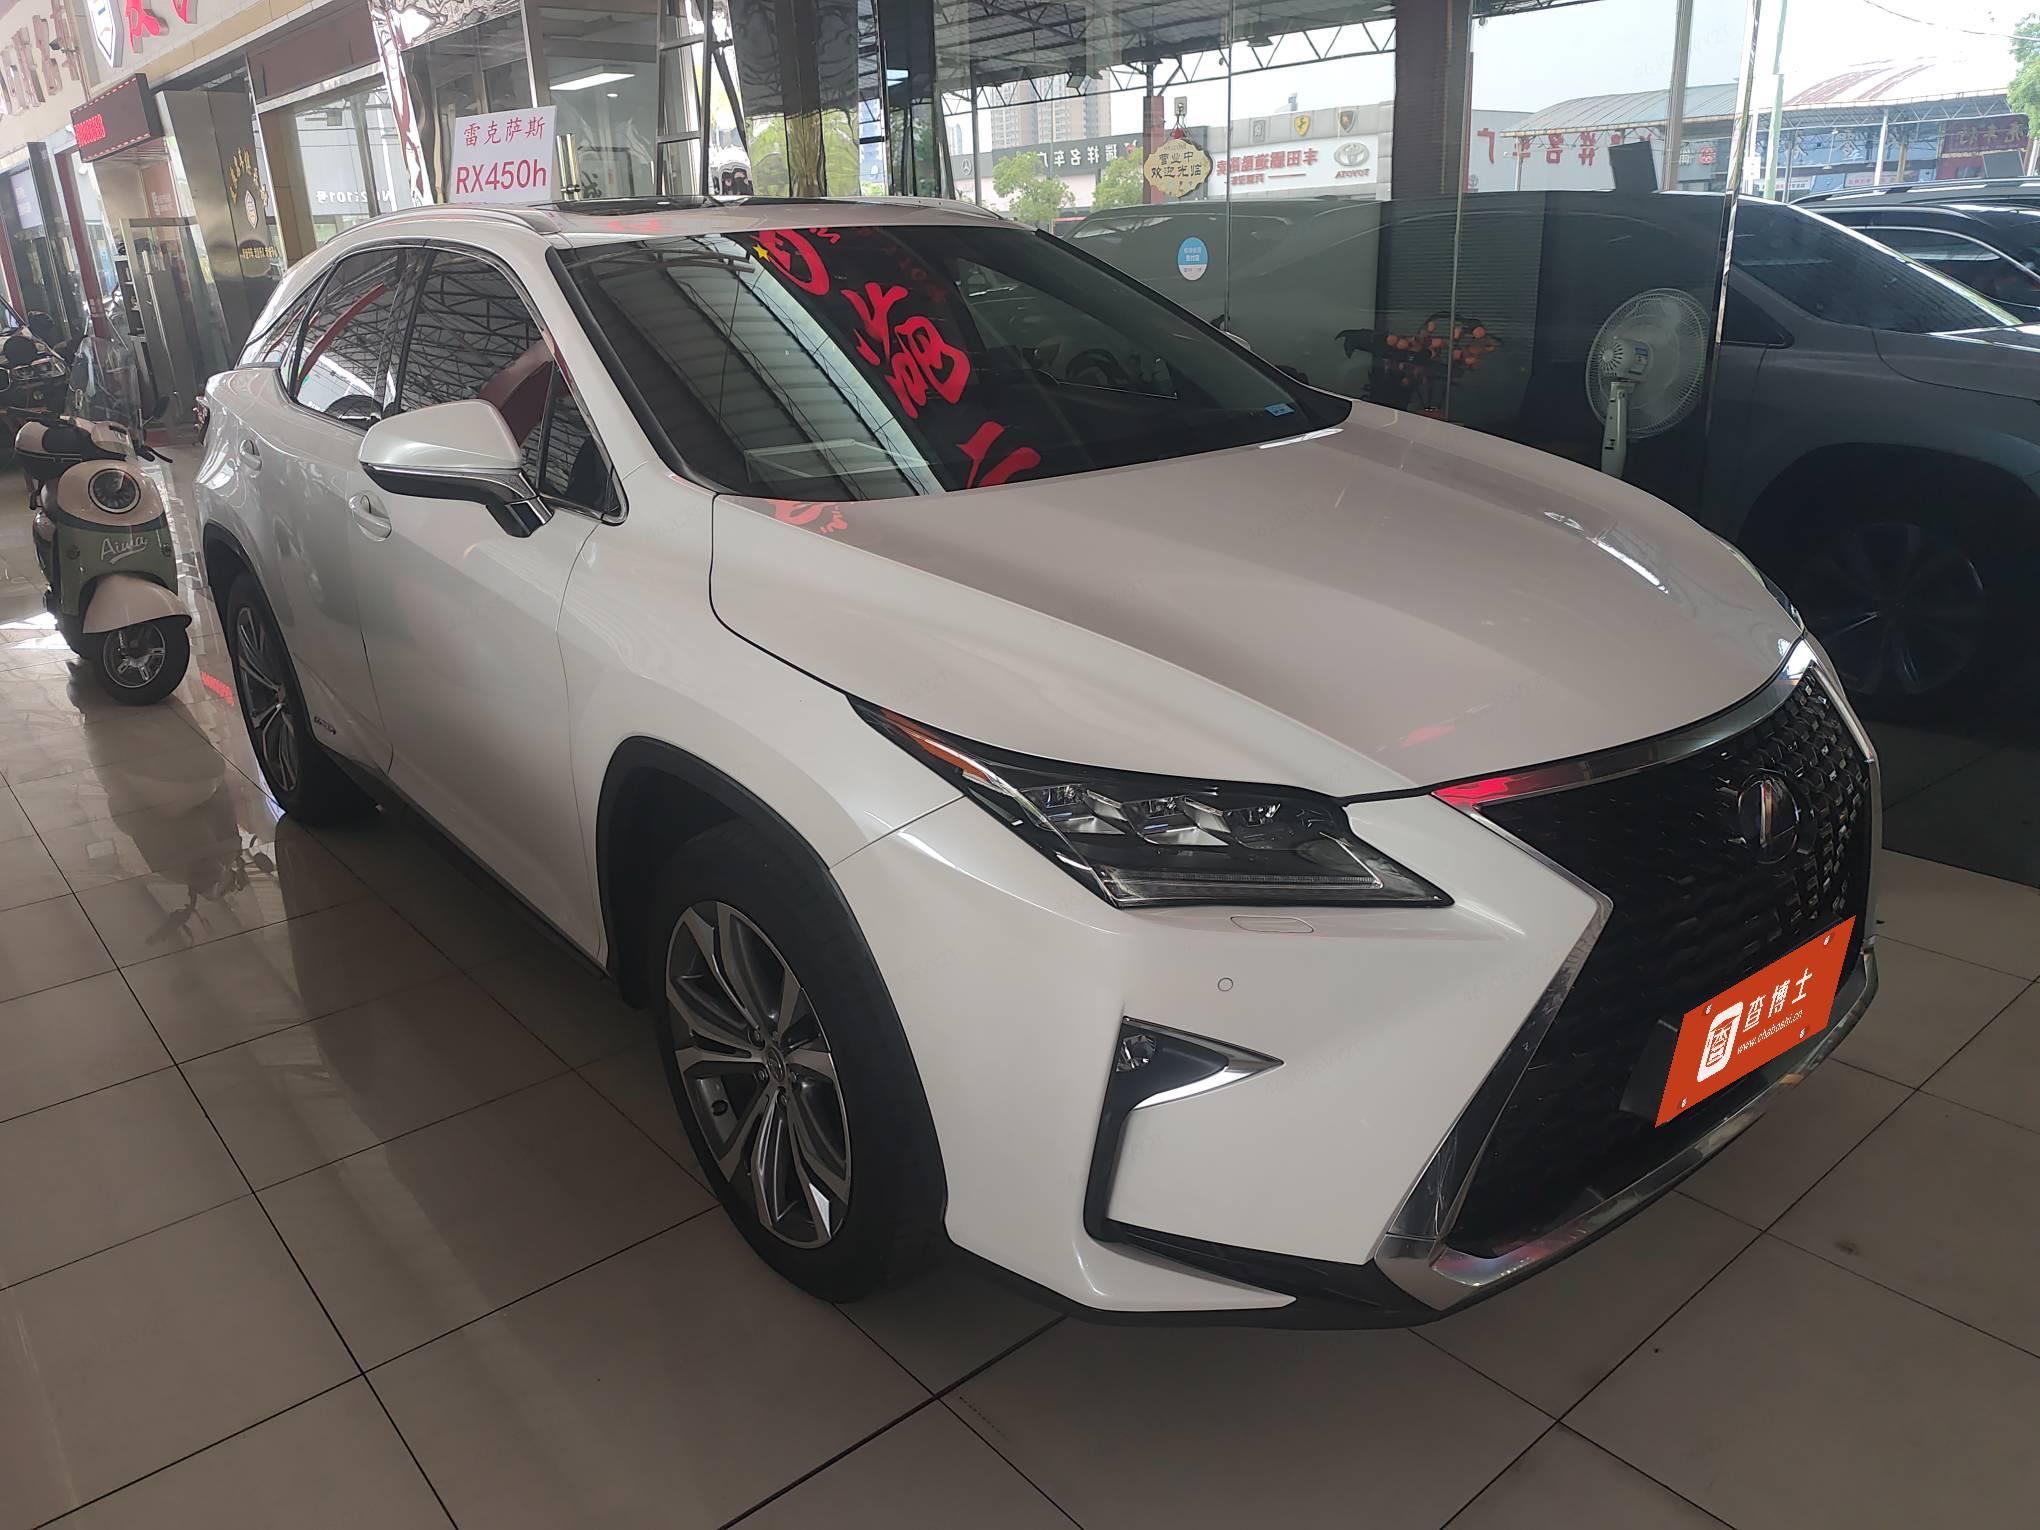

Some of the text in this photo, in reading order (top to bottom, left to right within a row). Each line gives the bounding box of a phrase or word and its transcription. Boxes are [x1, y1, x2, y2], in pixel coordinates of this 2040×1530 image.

[463, 116, 546, 147] 雷克萨斯
[1159, 151, 1194, 165] 营业中
[456, 159, 547, 194] RX450h
[1151, 163, 1202, 179] 欢迎光临
